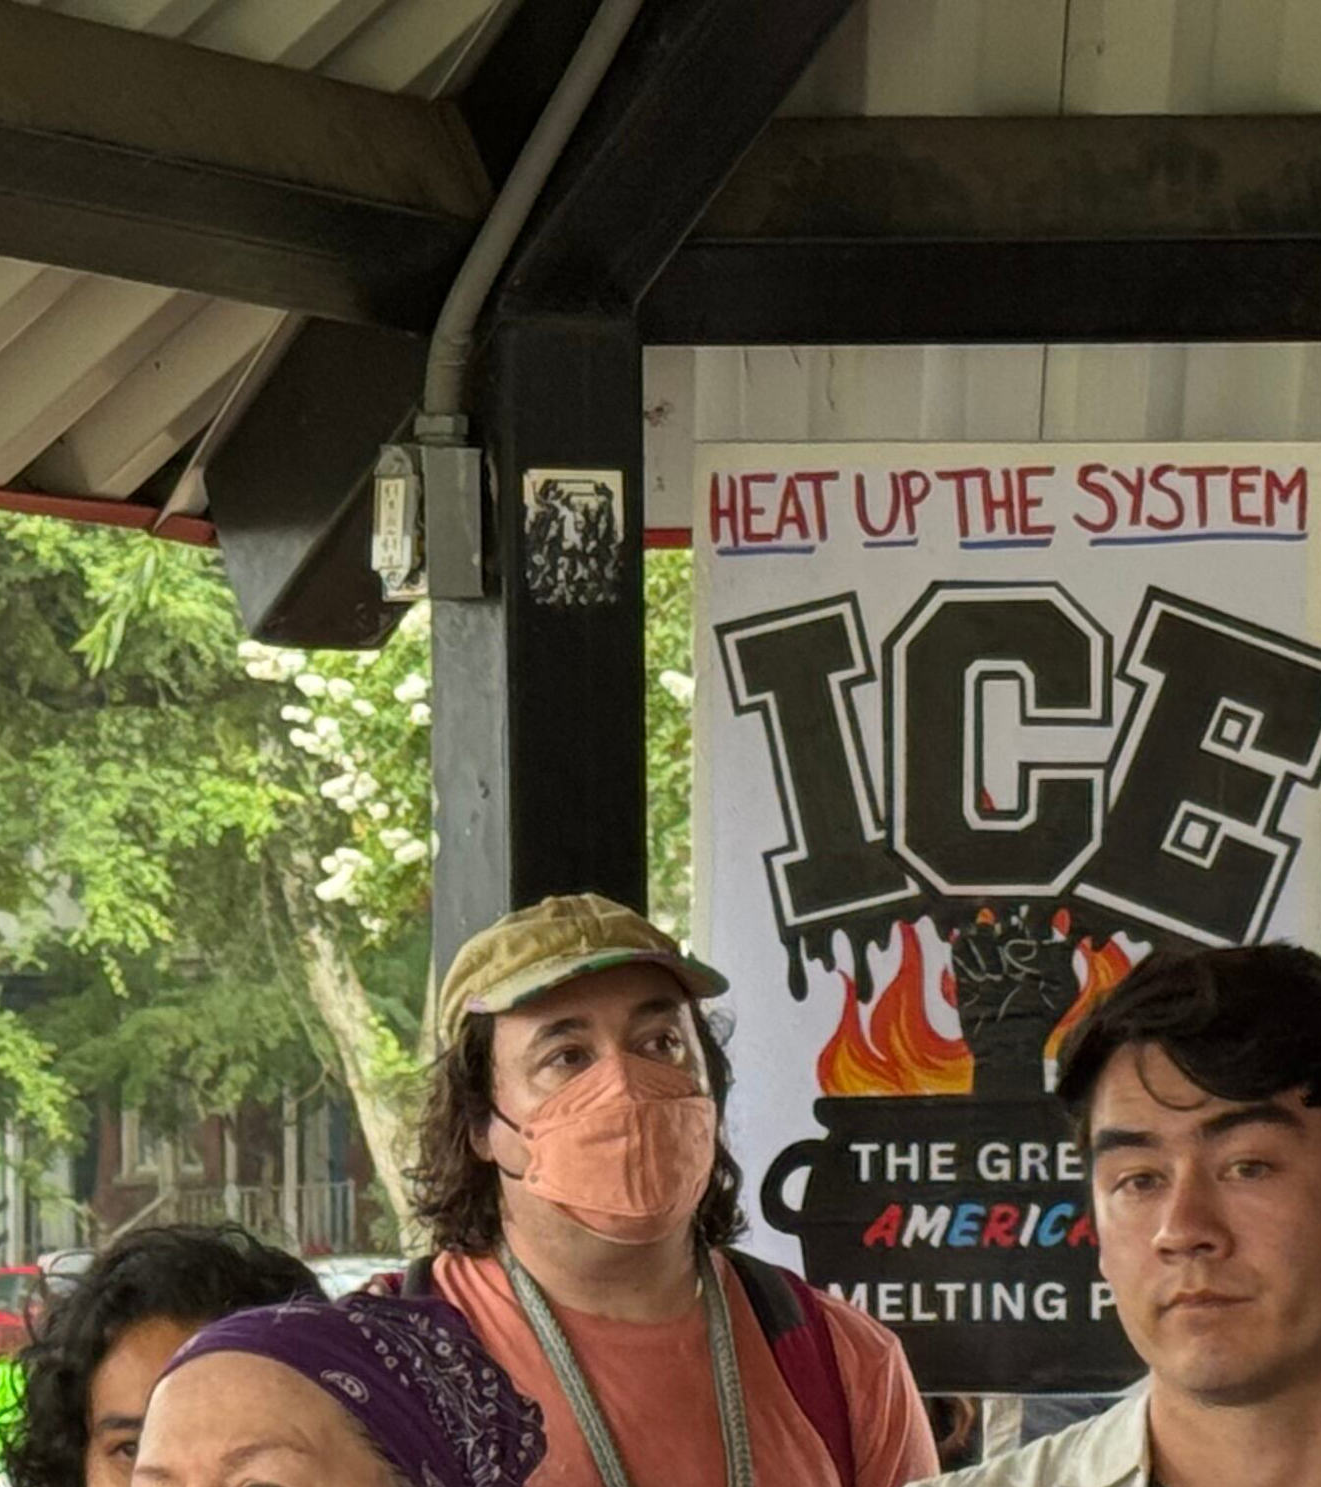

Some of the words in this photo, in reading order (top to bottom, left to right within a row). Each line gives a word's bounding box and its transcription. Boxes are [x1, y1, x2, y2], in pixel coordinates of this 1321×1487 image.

[710, 470, 840, 547] HEAT
[855, 470, 932, 537] UP
[936, 465, 1056, 537] THE
[1074, 463, 1308, 533] SYSTEM
[848, 1143, 958, 1182] THE
[977, 1143, 1085, 1181] GRE
[862, 1203, 1100, 1249] AMERICA
[827, 1283, 1067, 1321] MELTING
